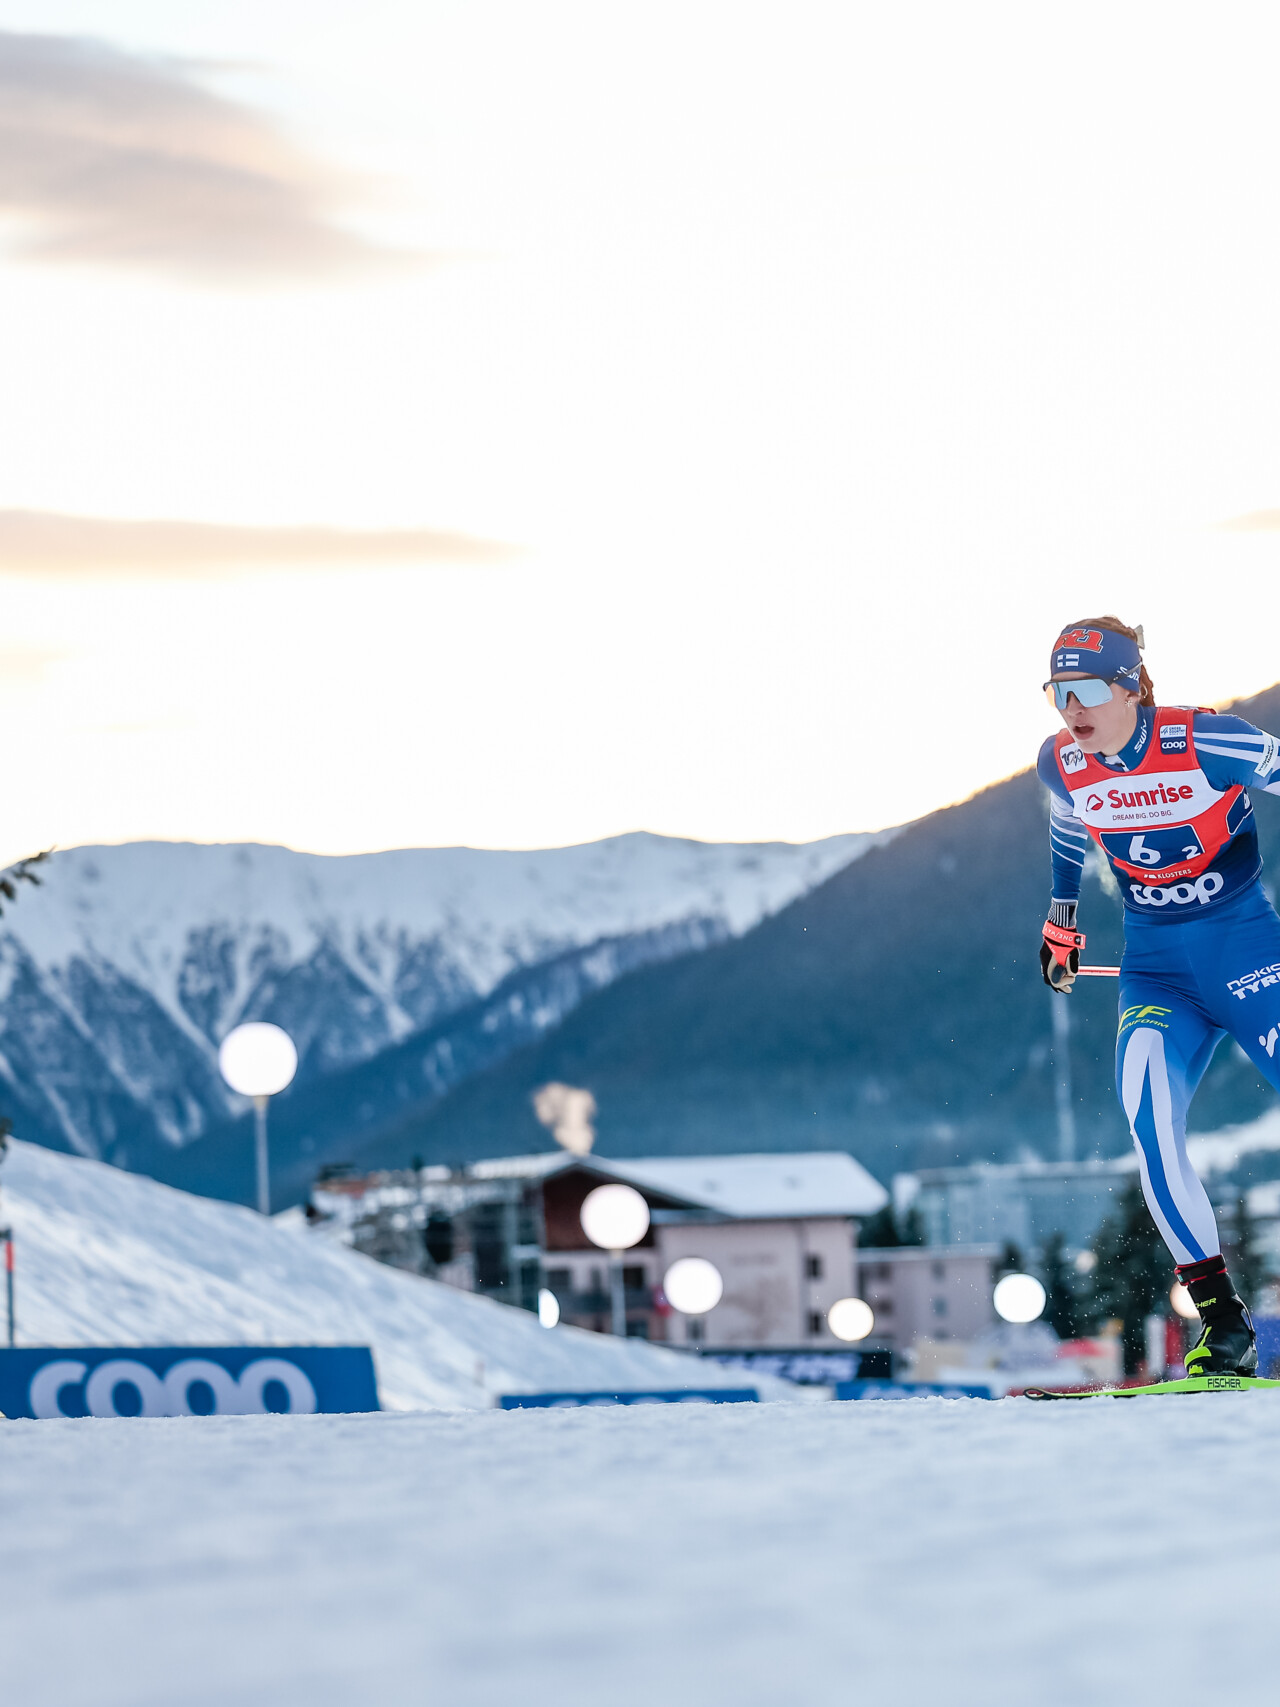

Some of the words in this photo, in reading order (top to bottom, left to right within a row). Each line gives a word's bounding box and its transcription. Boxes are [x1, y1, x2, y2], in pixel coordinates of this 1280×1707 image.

[1161, 740, 1187, 750] coop
[1107, 782, 1194, 809] Sunrise
[1112, 813, 1135, 821] DREAM
[1136, 812, 1149, 820] BIG.
[1160, 809, 1174, 817] BIG.
[1128, 834, 1162, 865] 6
[1181, 845, 1202, 861] 2
[1157, 868, 1192, 880] KLOSTERS
[1129, 871, 1224, 907] coop
[1207, 1377, 1242, 1389] FISCHER
